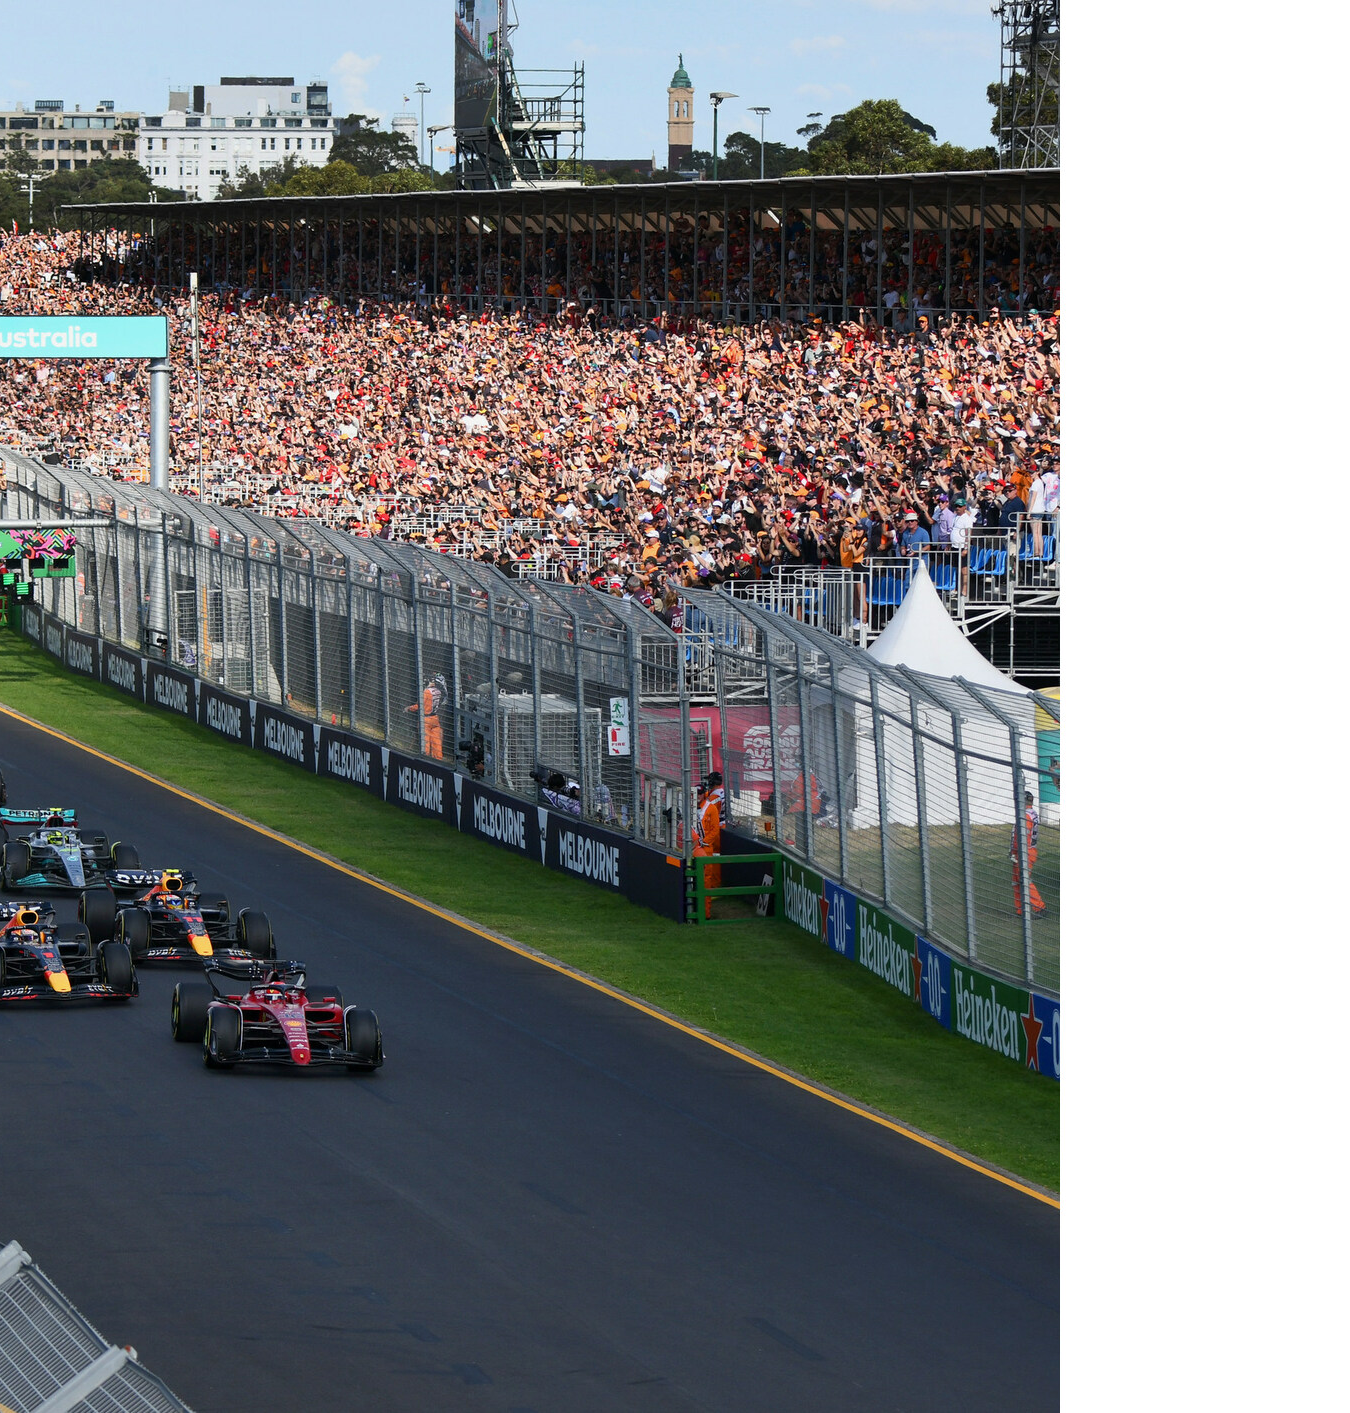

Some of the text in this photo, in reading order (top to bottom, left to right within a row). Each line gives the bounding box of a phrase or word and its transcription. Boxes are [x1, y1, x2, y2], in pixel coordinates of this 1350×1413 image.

[107, 653, 136, 693] MELBOURNE
[153, 673, 188, 714] MELBOURNE
[206, 699, 242, 739] MELBOURNE
[263, 717, 304, 763] MELBOURNE
[327, 740, 370, 786] MELBOURNE
[398, 764, 443, 814] MELBOURNE
[8, 809, 66, 818] PETRONS
[473, 793, 526, 850] MELBOURNE
[558, 829, 620, 887] MELBOURNE
[858, 904, 911, 997] Heineken
[953, 967, 1020, 1062] Heineken
